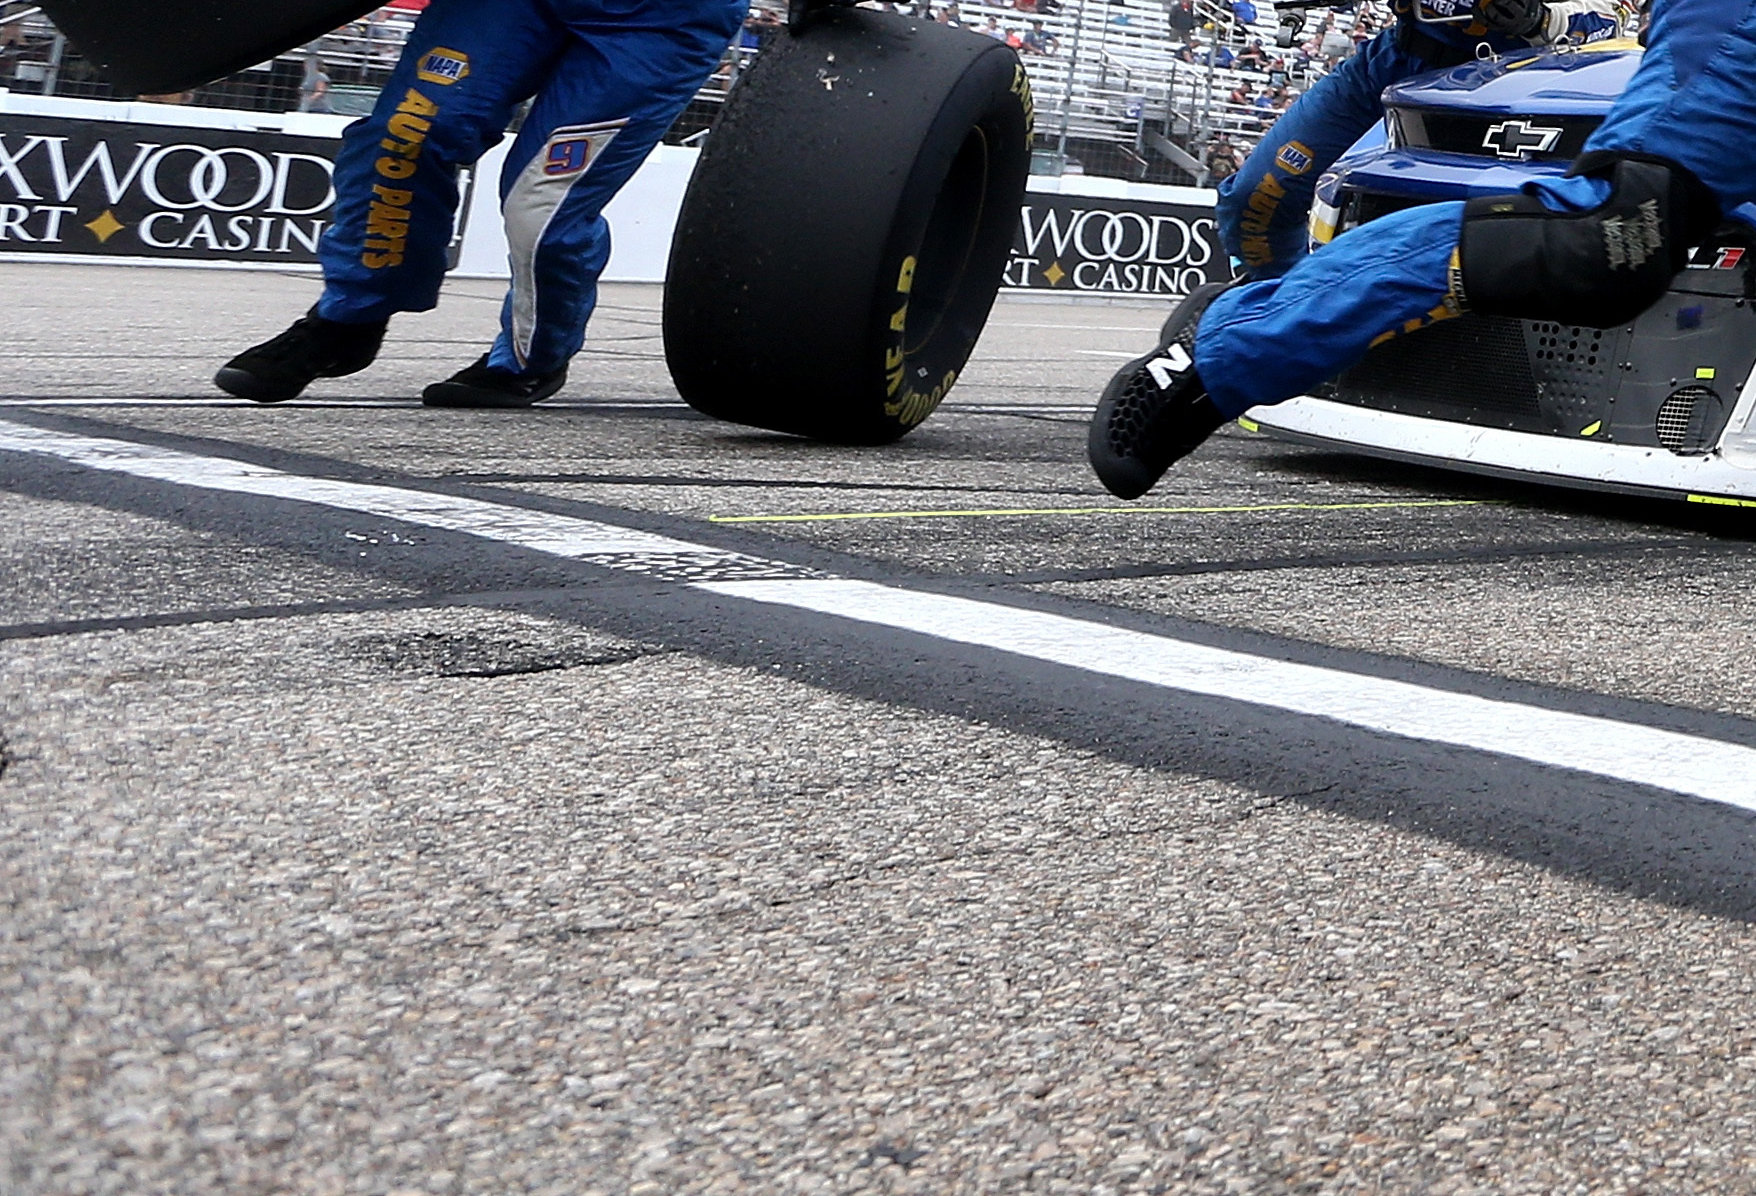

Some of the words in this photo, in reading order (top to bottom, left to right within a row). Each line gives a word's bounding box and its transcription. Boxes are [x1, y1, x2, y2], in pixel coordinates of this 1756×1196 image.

[425, 55, 463, 77] NAPA
[375, 88, 440, 179] AUTO
[0, 133, 337, 215] XWOOD
[544, 138, 590, 176] 9
[1281, 147, 1310, 171] NAPA
[138, 211, 330, 253] CASIN
[361, 184, 413, 269] PARTS
[1021, 206, 1214, 266] WOODS
[1073, 262, 1206, 294] CASINO
